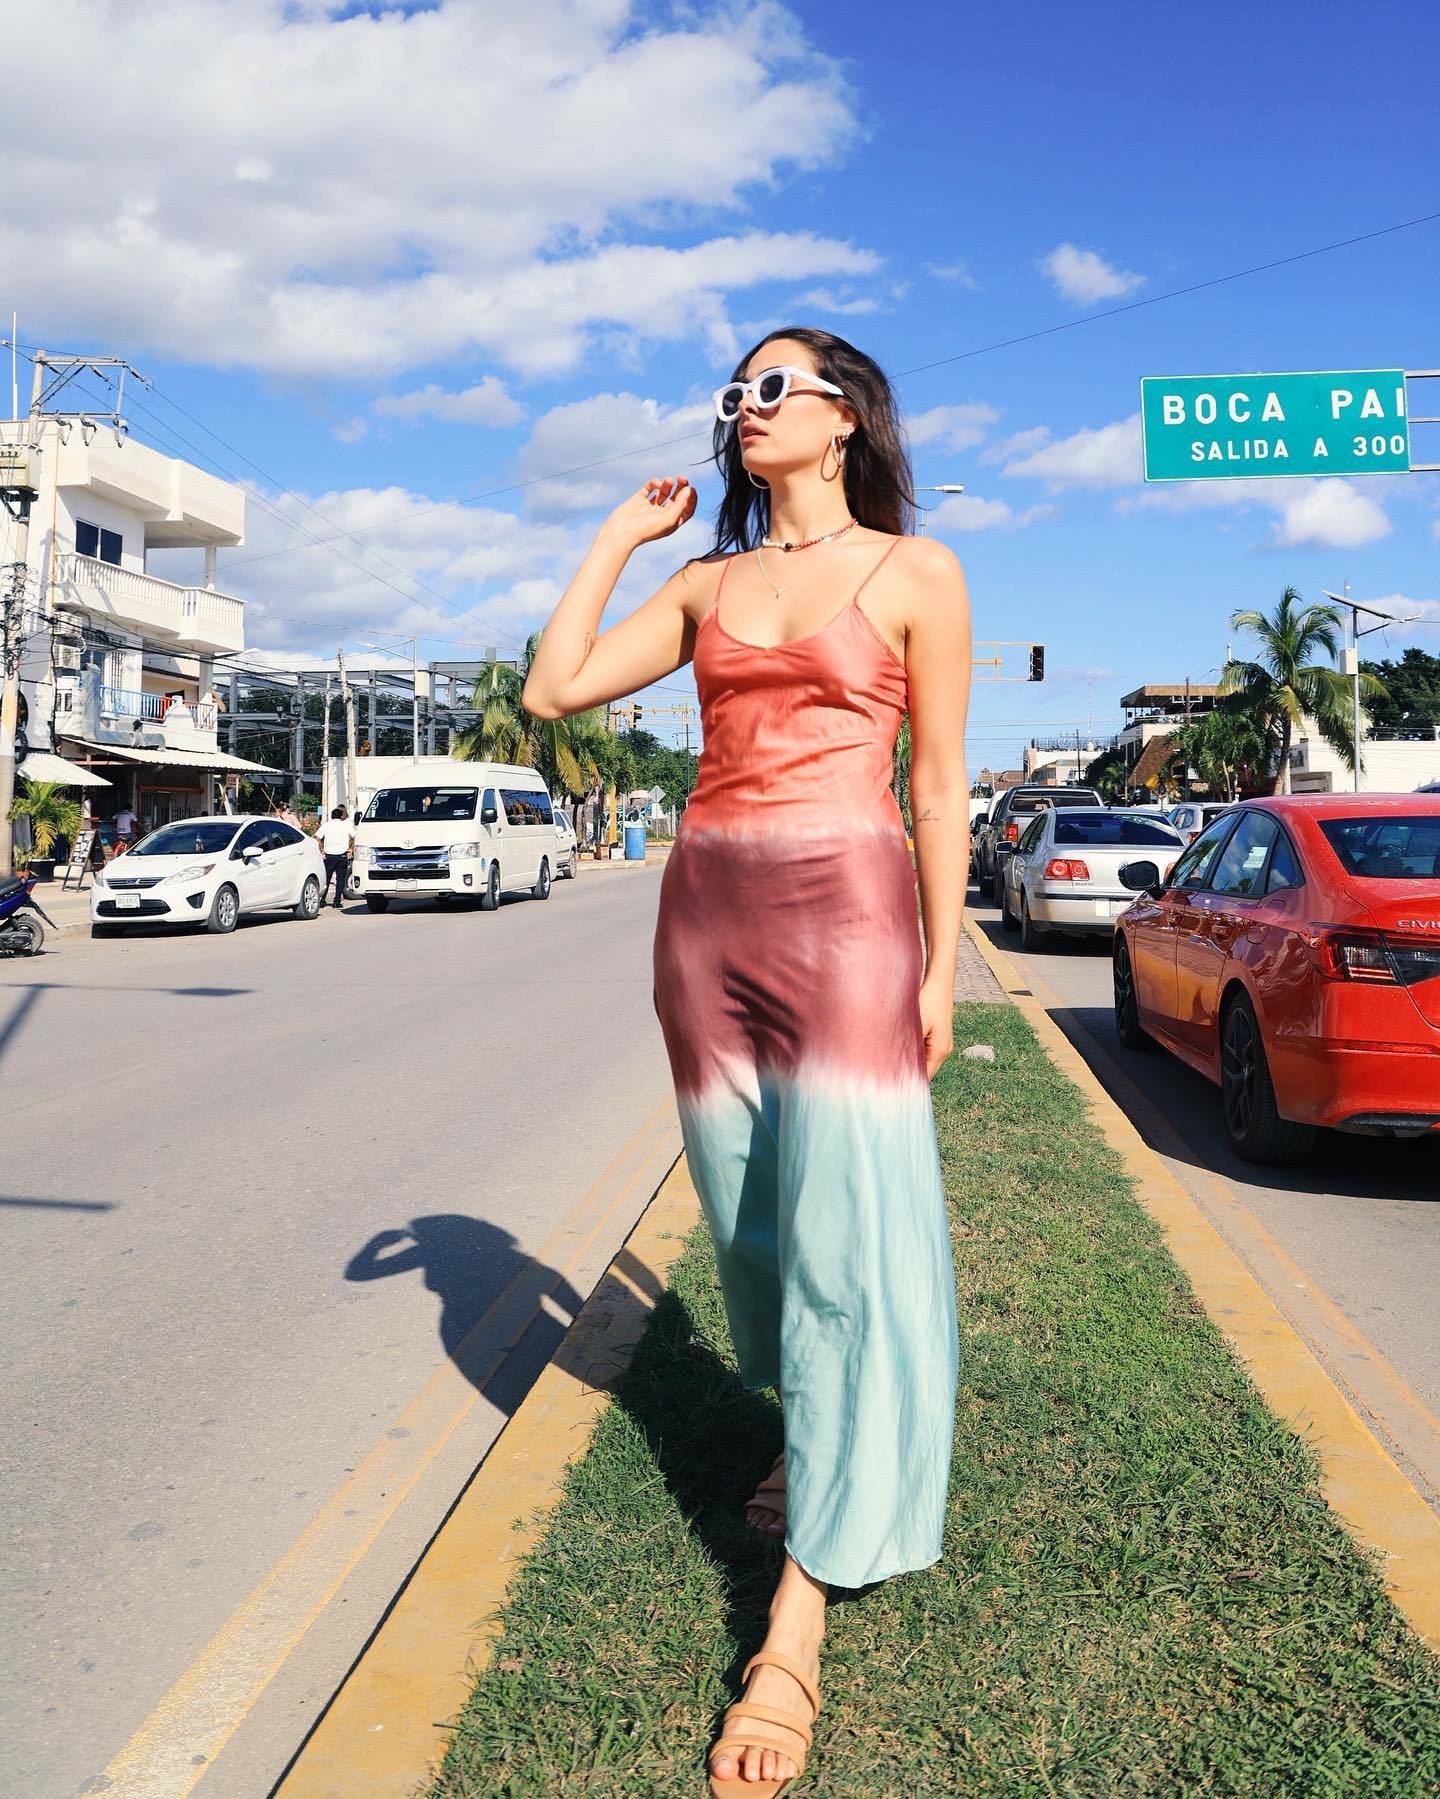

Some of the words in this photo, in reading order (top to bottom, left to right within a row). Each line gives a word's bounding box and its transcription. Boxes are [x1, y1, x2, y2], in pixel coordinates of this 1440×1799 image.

[1162, 391, 1286, 425] BOCA
[1330, 387, 1405, 419] PAI
[1191, 439, 1289, 461] SALIDA
[1312, 437, 1329, 457] A
[1352, 435, 1405, 457] 300
